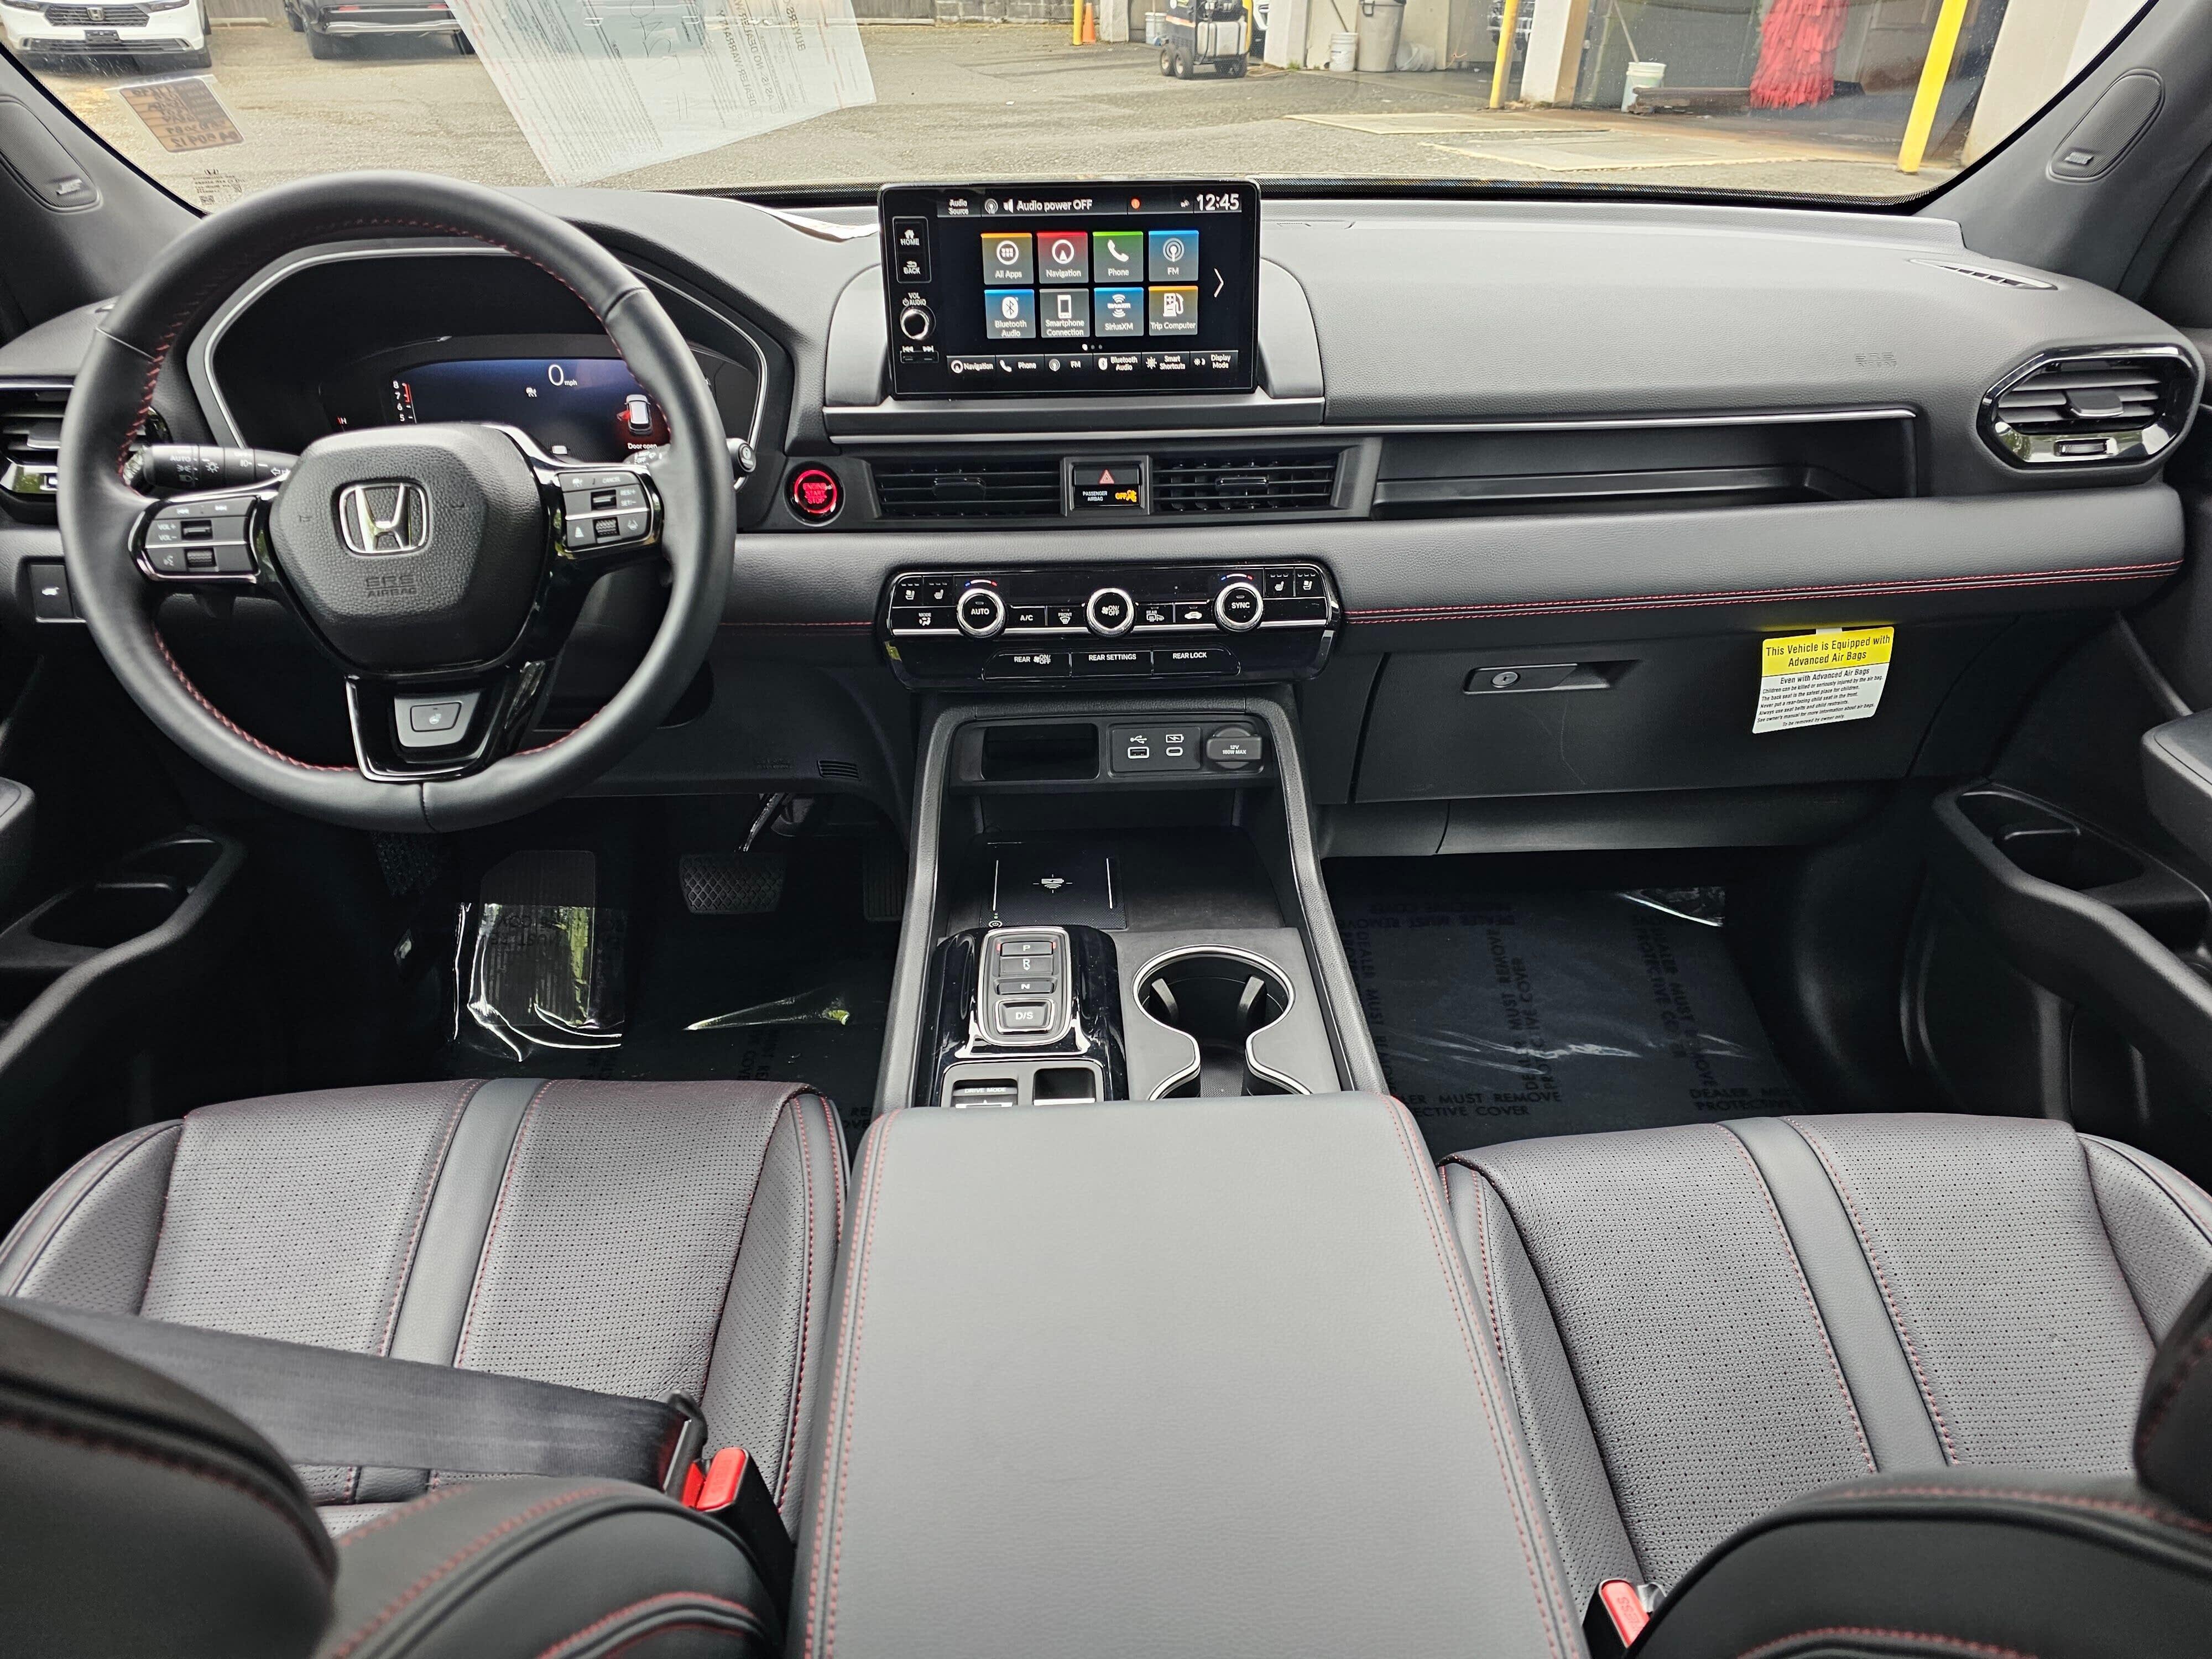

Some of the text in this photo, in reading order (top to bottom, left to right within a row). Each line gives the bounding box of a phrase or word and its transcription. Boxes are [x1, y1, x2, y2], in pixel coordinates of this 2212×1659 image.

[950, 199, 968, 207] Audio
[1016, 199, 1093, 212] Audio power OFF
[1196, 194, 1239, 211] 12:45
[1005, 270, 1022, 279] Apps
[1046, 269, 1081, 279] Navigation
[1108, 268, 1129, 276] Phone
[1045, 319, 1085, 328] Smartphone
[1105, 322, 1133, 331] SiriusXM
[1150, 321, 1196, 330] Trip Computer
[1211, 354, 1230, 363] Display
[963, 362, 994, 371] Navigation
[1018, 361, 1037, 369] Phone
[1070, 361, 1082, 369] FM
[548, 364, 564, 386] 0
[393, 380, 399, 389] 8
[394, 392, 400, 400] 7
[1766, 635, 1890, 656] This Vehicle is Equipped with
[1788, 651, 1867, 667] Advanced Air Bags
[1812, 671, 1842, 681] Advanced
[1022, 959, 1030, 967] R
[1015, 1012, 1034, 1020] D/S
[1438, 1093, 1483, 1104] MUST
[1493, 1091, 1562, 1103] REMOVE
[1475, 1105, 1530, 1117] COVER
